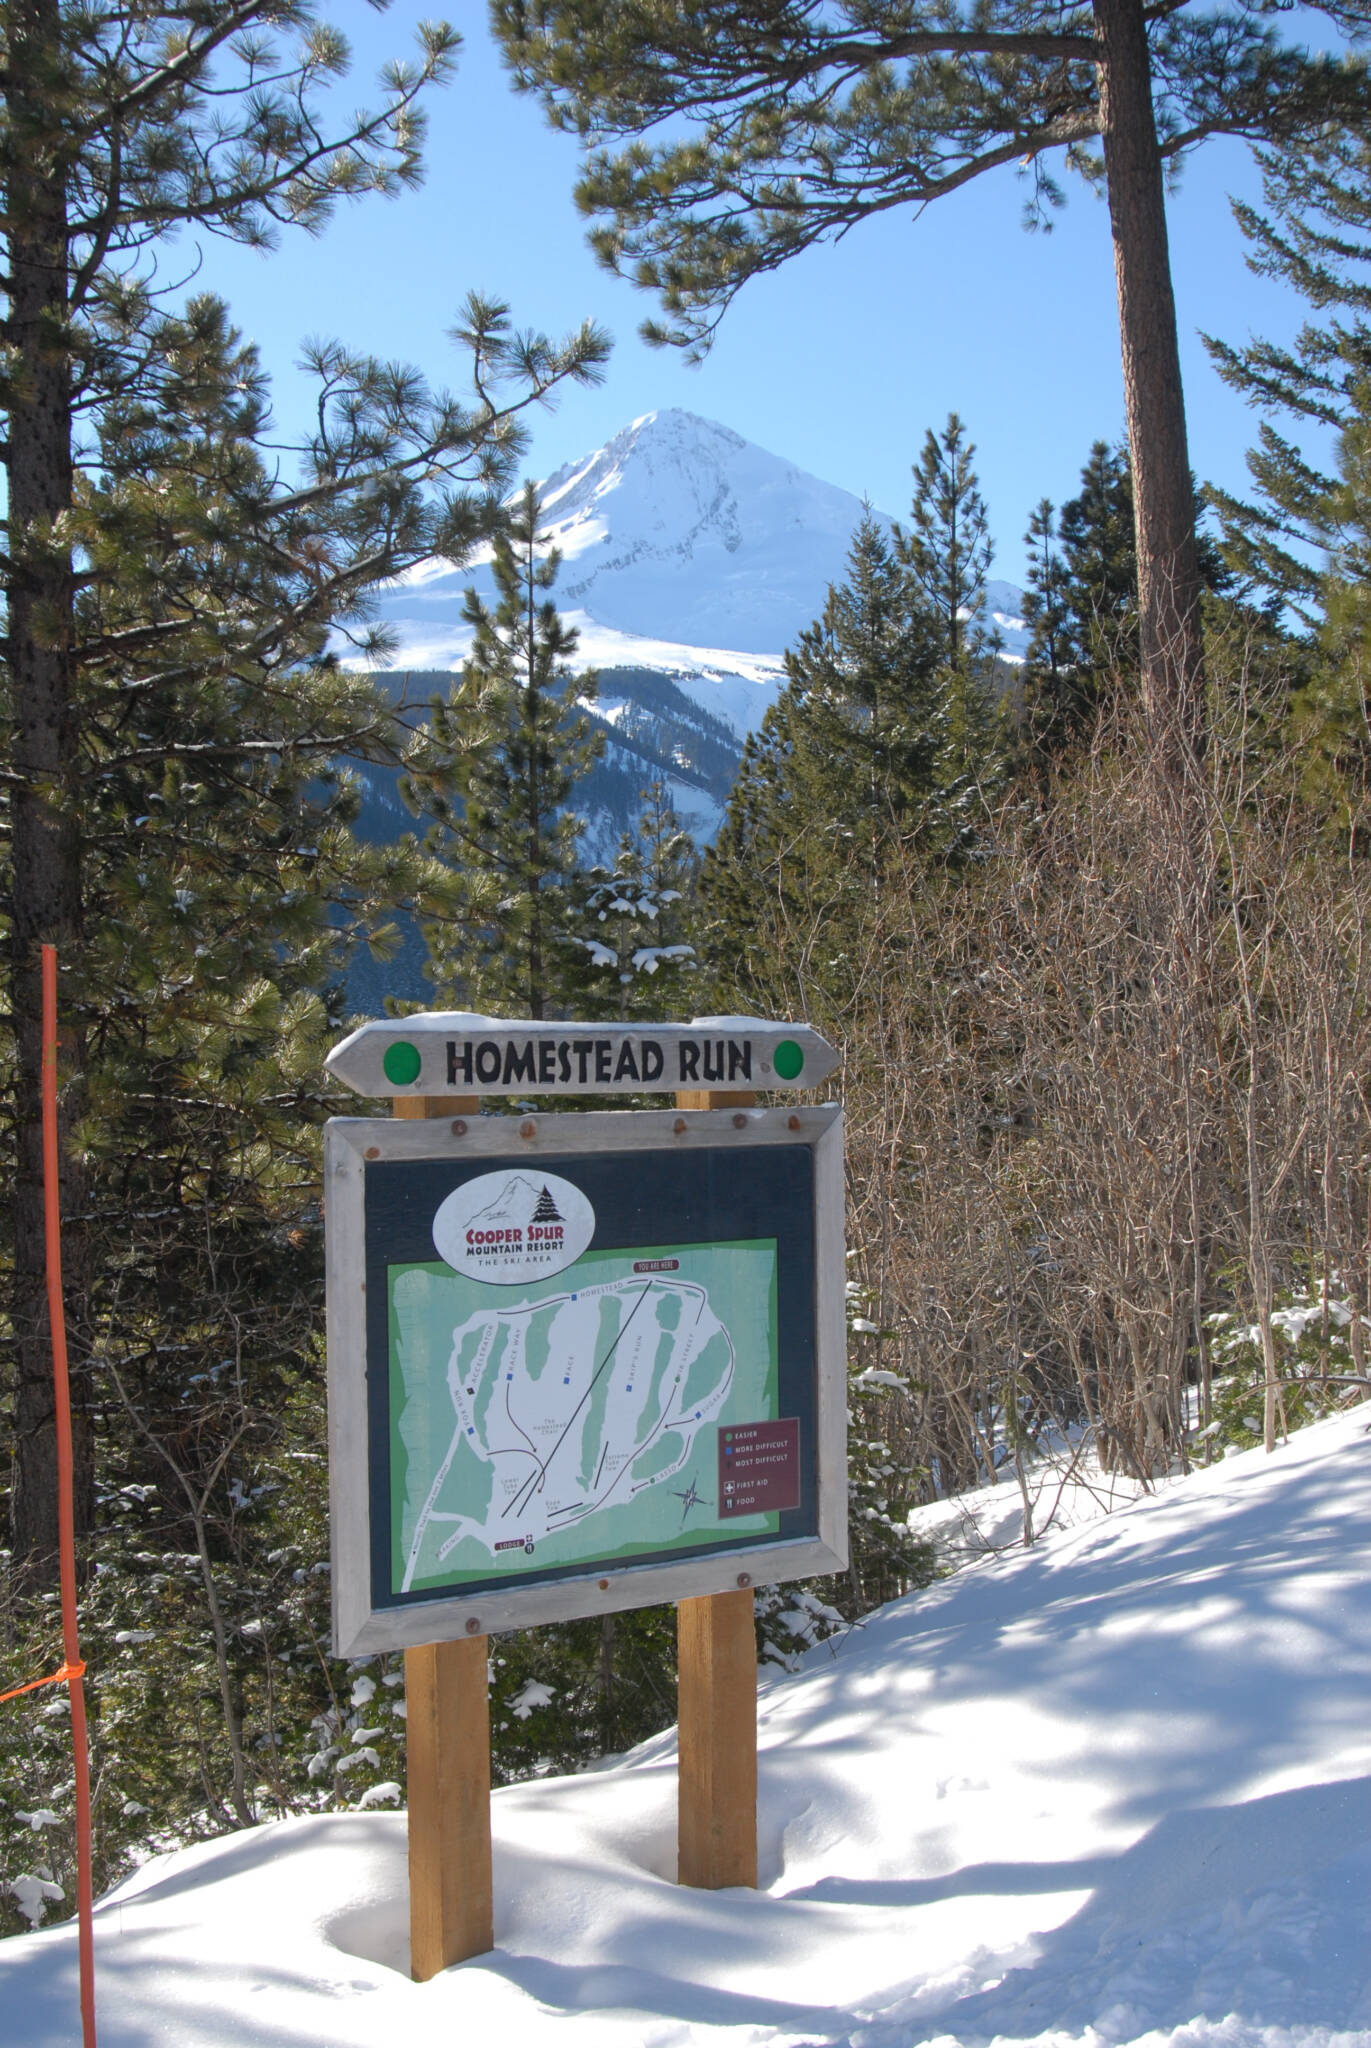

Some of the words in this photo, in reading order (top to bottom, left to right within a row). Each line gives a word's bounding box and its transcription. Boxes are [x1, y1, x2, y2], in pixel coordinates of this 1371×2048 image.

[446, 1040, 664, 1085] HOMESTEAD
[679, 1039, 753, 1082] RUN
[465, 1228, 523, 1245] COOPER
[527, 1225, 564, 1241] SPUR
[466, 1242, 523, 1257] MOUNTAIN
[527, 1240, 564, 1252] RESORT
[478, 1258, 498, 1267] THE
[504, 1257, 520, 1265] SKI
[525, 1255, 552, 1263] AREA
[639, 1263, 649, 1271] YOU
[650, 1262, 660, 1270] ARE
[661, 1261, 673, 1269] HERE
[580, 1282, 623, 1297] HOMESTEAD
[472, 1325, 493, 1383] ACCELERATOR
[735, 1430, 757, 1440] EASIER
[735, 1446, 753, 1454] MORE
[755, 1440, 788, 1451] DIFFICULT
[735, 1459, 753, 1467] MOST
[755, 1454, 788, 1464] DIFFICULT
[656, 1465, 677, 1481] LASSO
[736, 1481, 755, 1489] FIRST
[736, 1497, 755, 1505] FOOD
[499, 1541, 521, 1550] LODGE
